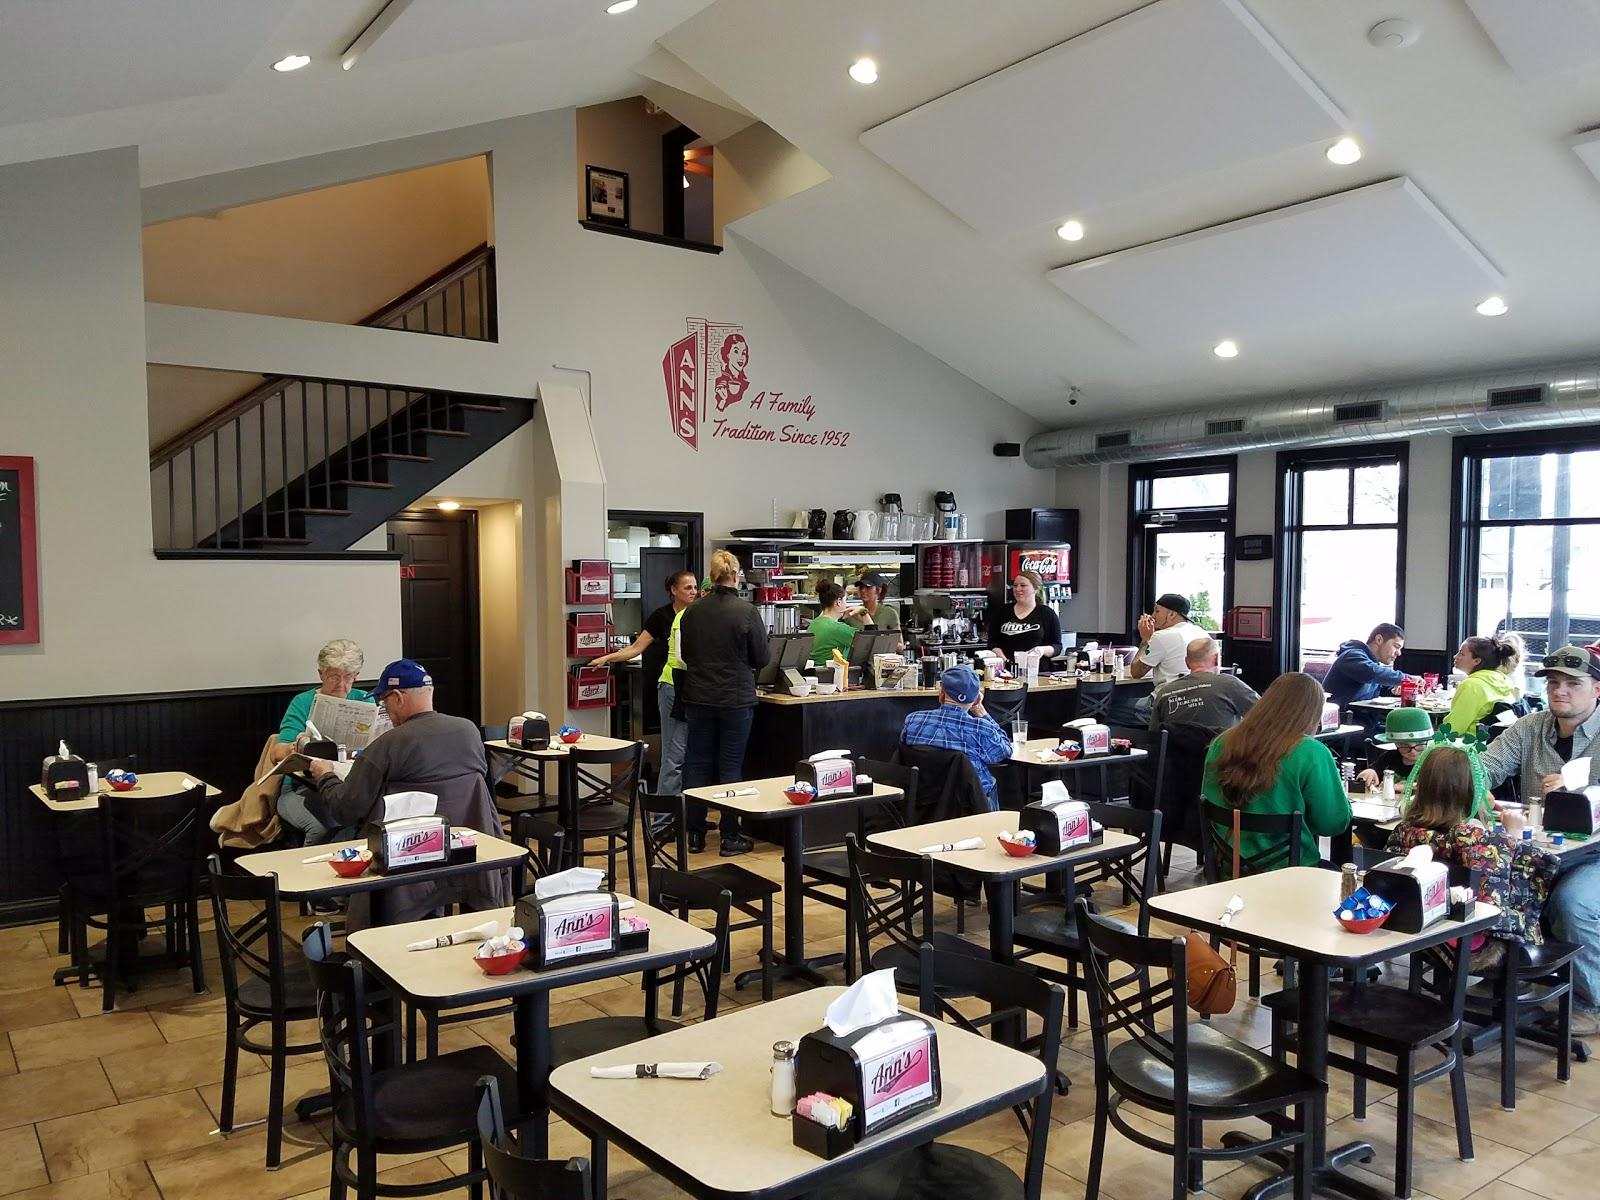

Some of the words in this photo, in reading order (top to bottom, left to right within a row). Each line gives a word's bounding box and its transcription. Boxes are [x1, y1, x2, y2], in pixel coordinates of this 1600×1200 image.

[750, 391, 766, 410] A
[769, 392, 816, 422] Family
[712, 418, 776, 442] Tradition
[779, 424, 818, 446] Since
[820, 430, 850, 447] 1952
[554, 911, 600, 939] Ann's
[871, 1050, 918, 1095] Ann's
